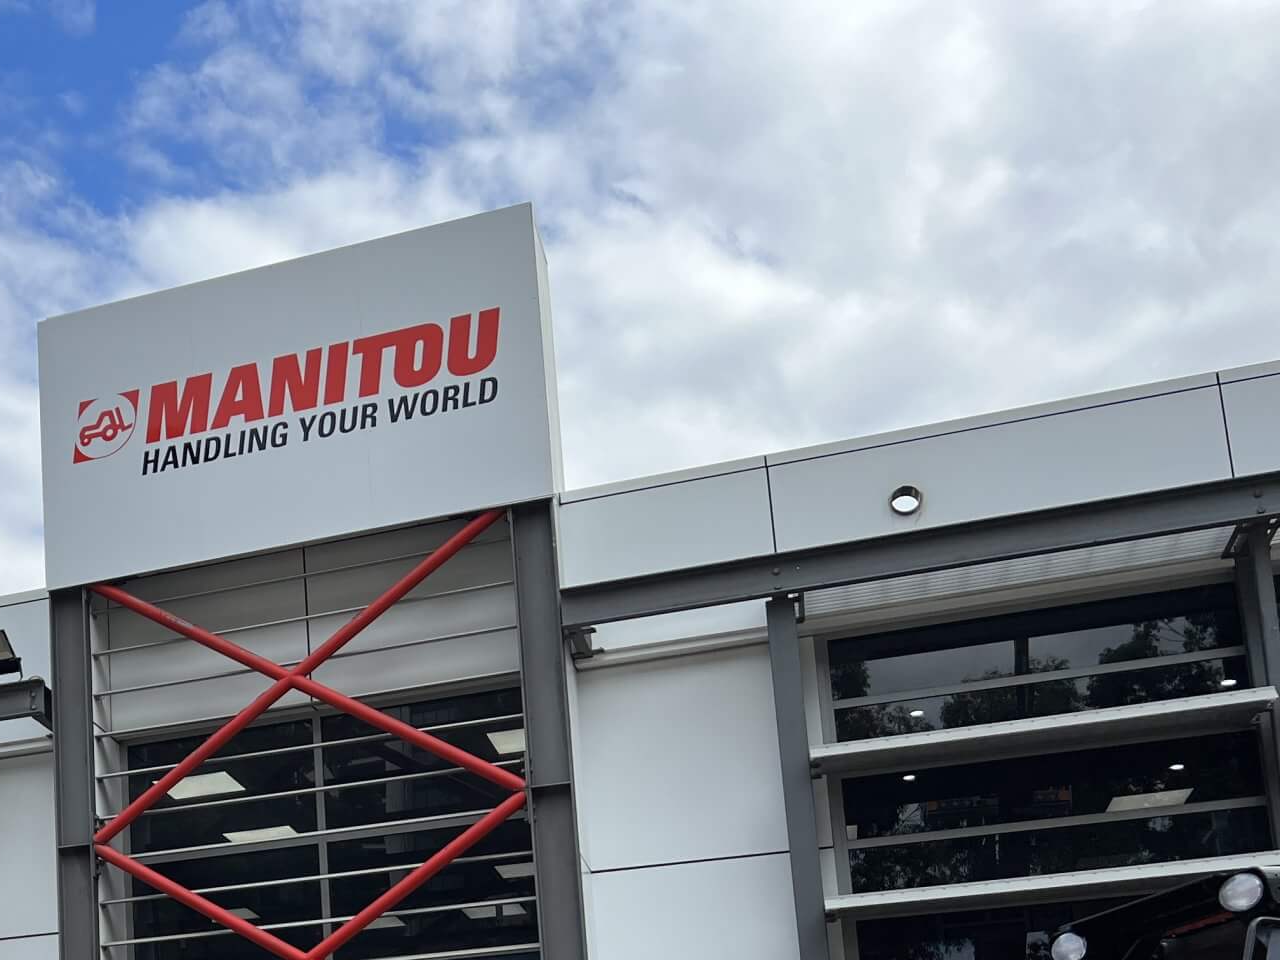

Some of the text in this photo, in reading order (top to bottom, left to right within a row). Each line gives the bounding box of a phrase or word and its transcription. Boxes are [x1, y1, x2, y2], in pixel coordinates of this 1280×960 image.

[141, 377, 498, 475] HANDLING YOUR WORLD
[146, 307, 501, 444] MANITOU
